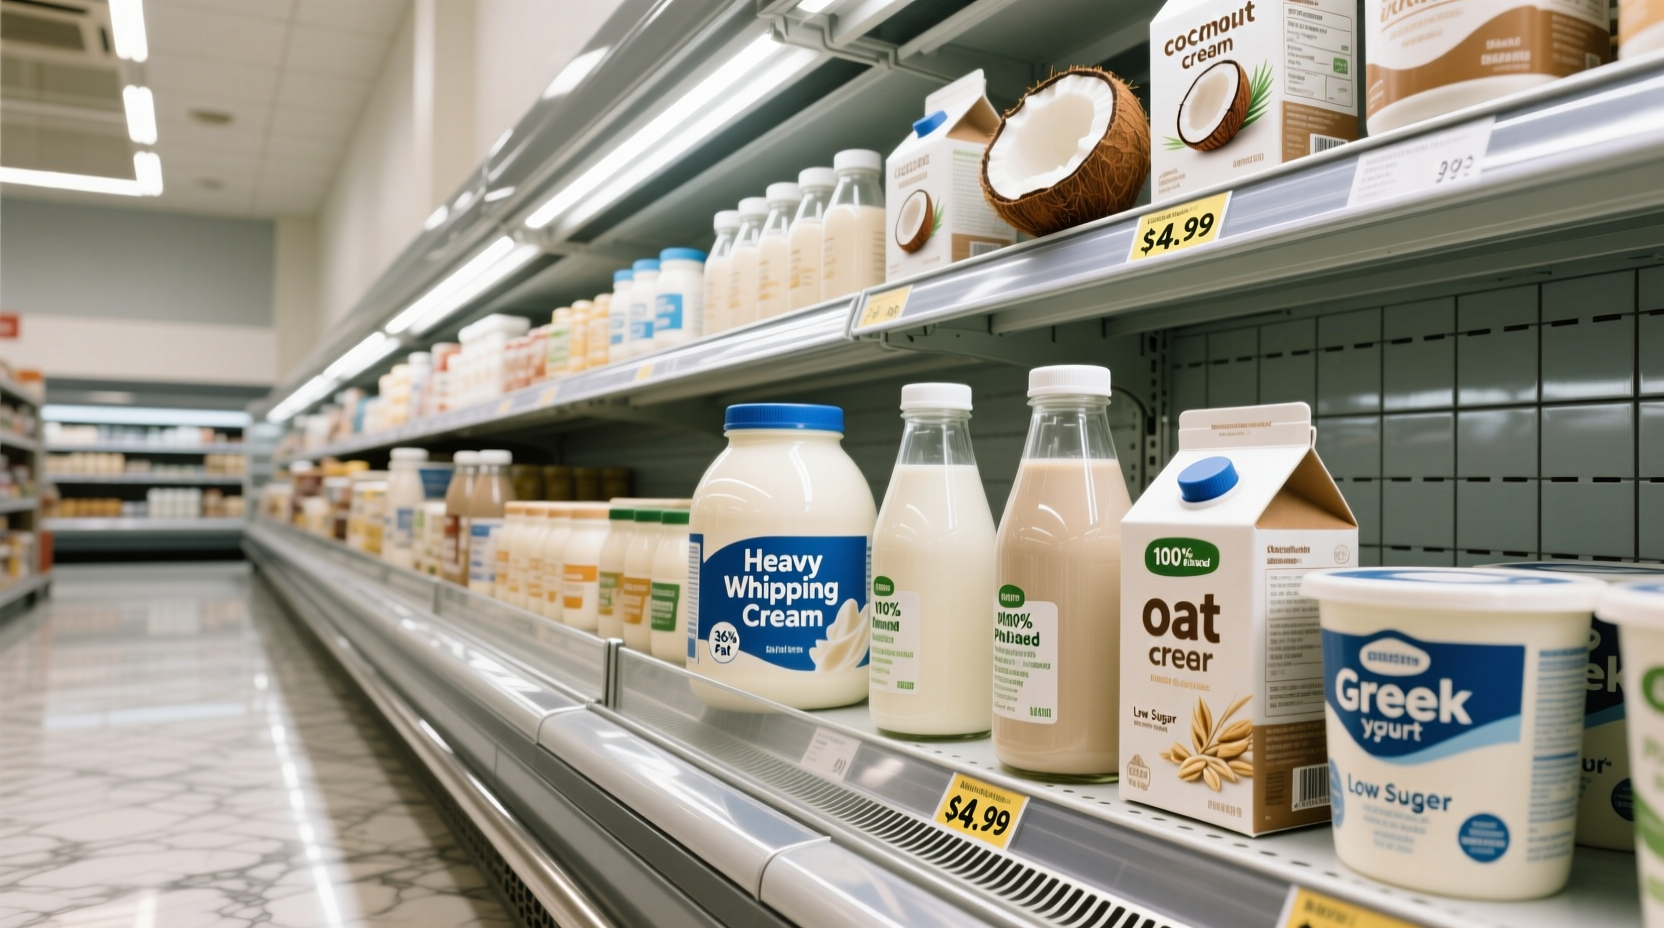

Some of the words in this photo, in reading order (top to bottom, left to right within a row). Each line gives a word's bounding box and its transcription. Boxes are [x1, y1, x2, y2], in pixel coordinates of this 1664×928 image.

[1182, 38, 1233, 69] cream
[1140, 212, 1214, 256] $4.99
[744, 548, 823, 579] Heavy
[1153, 546, 1193, 567] 100%
[723, 574, 839, 606] Whipping
[742, 603, 823, 627] Cream
[1142, 593, 1221, 644] oat
[714, 630, 737, 643] 36%
[1335, 667, 1473, 725] Greek
[1347, 772, 1379, 799] Low
[945, 794, 1011, 836] $4.99
